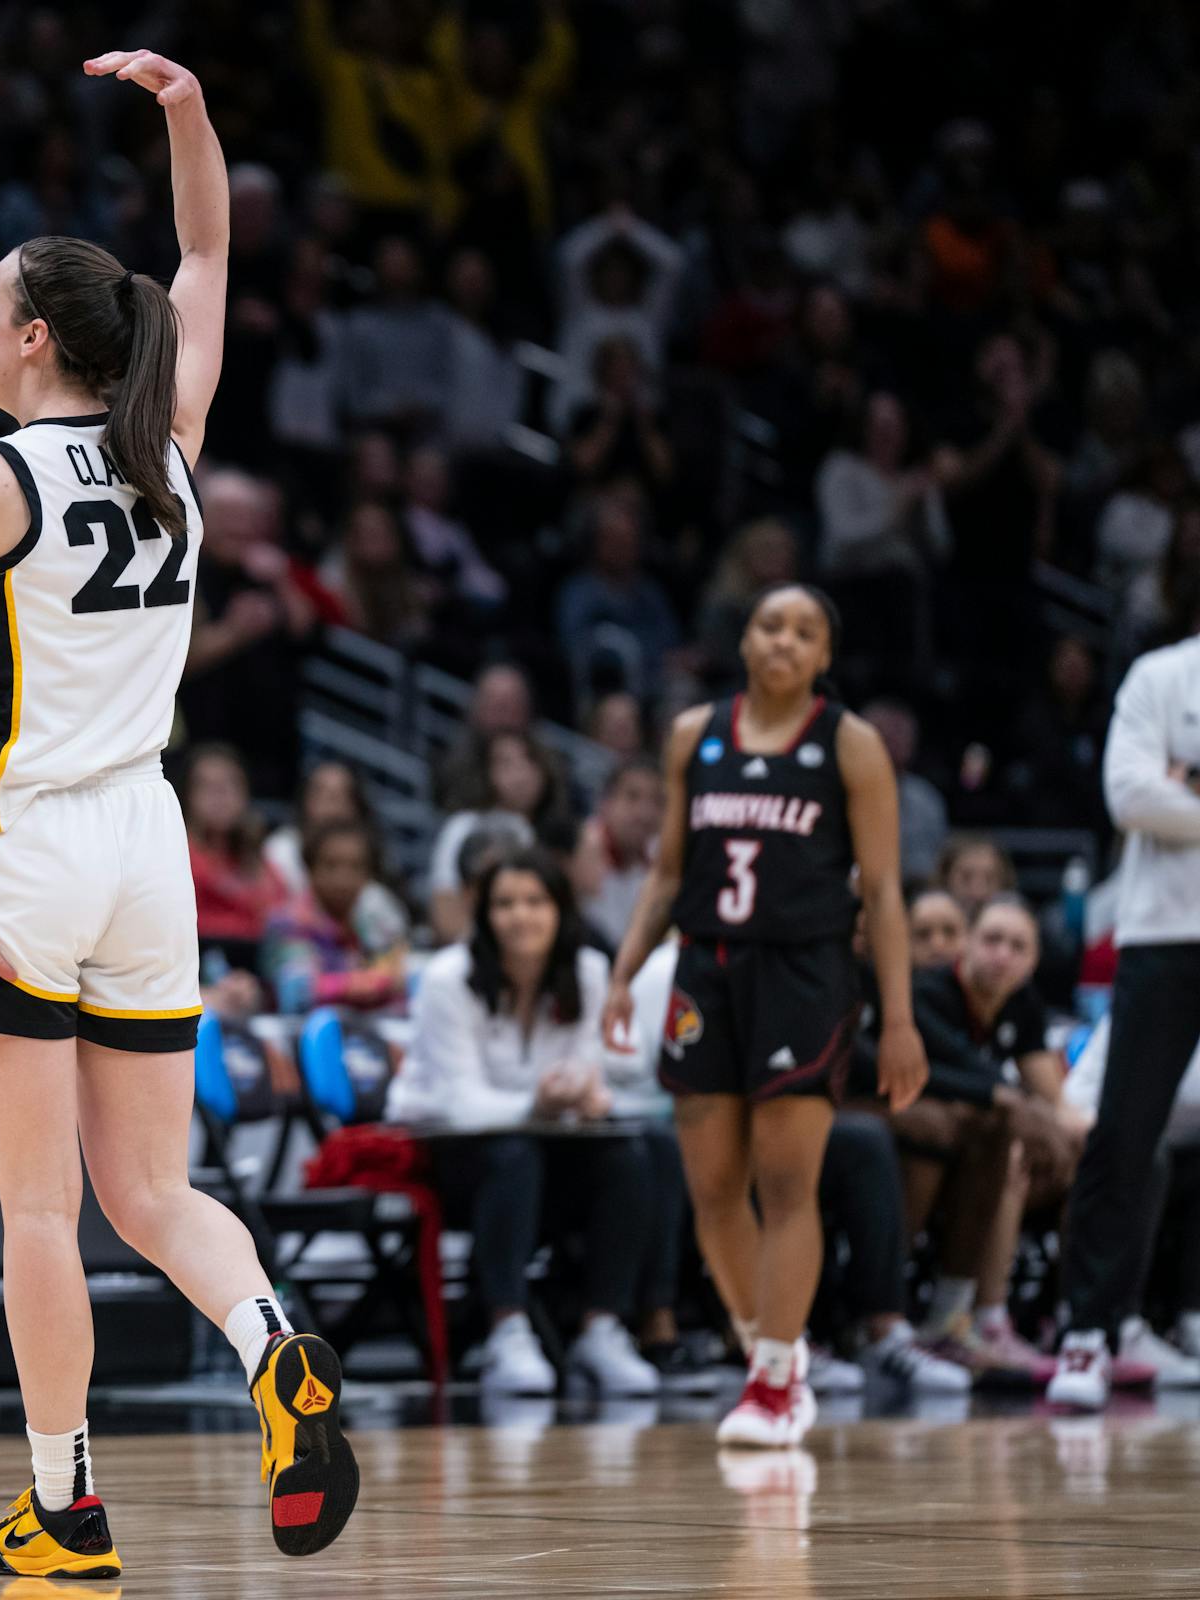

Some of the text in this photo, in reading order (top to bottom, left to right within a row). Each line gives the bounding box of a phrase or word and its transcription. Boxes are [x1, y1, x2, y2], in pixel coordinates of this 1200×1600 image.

[66, 444, 128, 487] CLA
[63, 493, 190, 614] 22
[716, 837, 764, 926] 3
